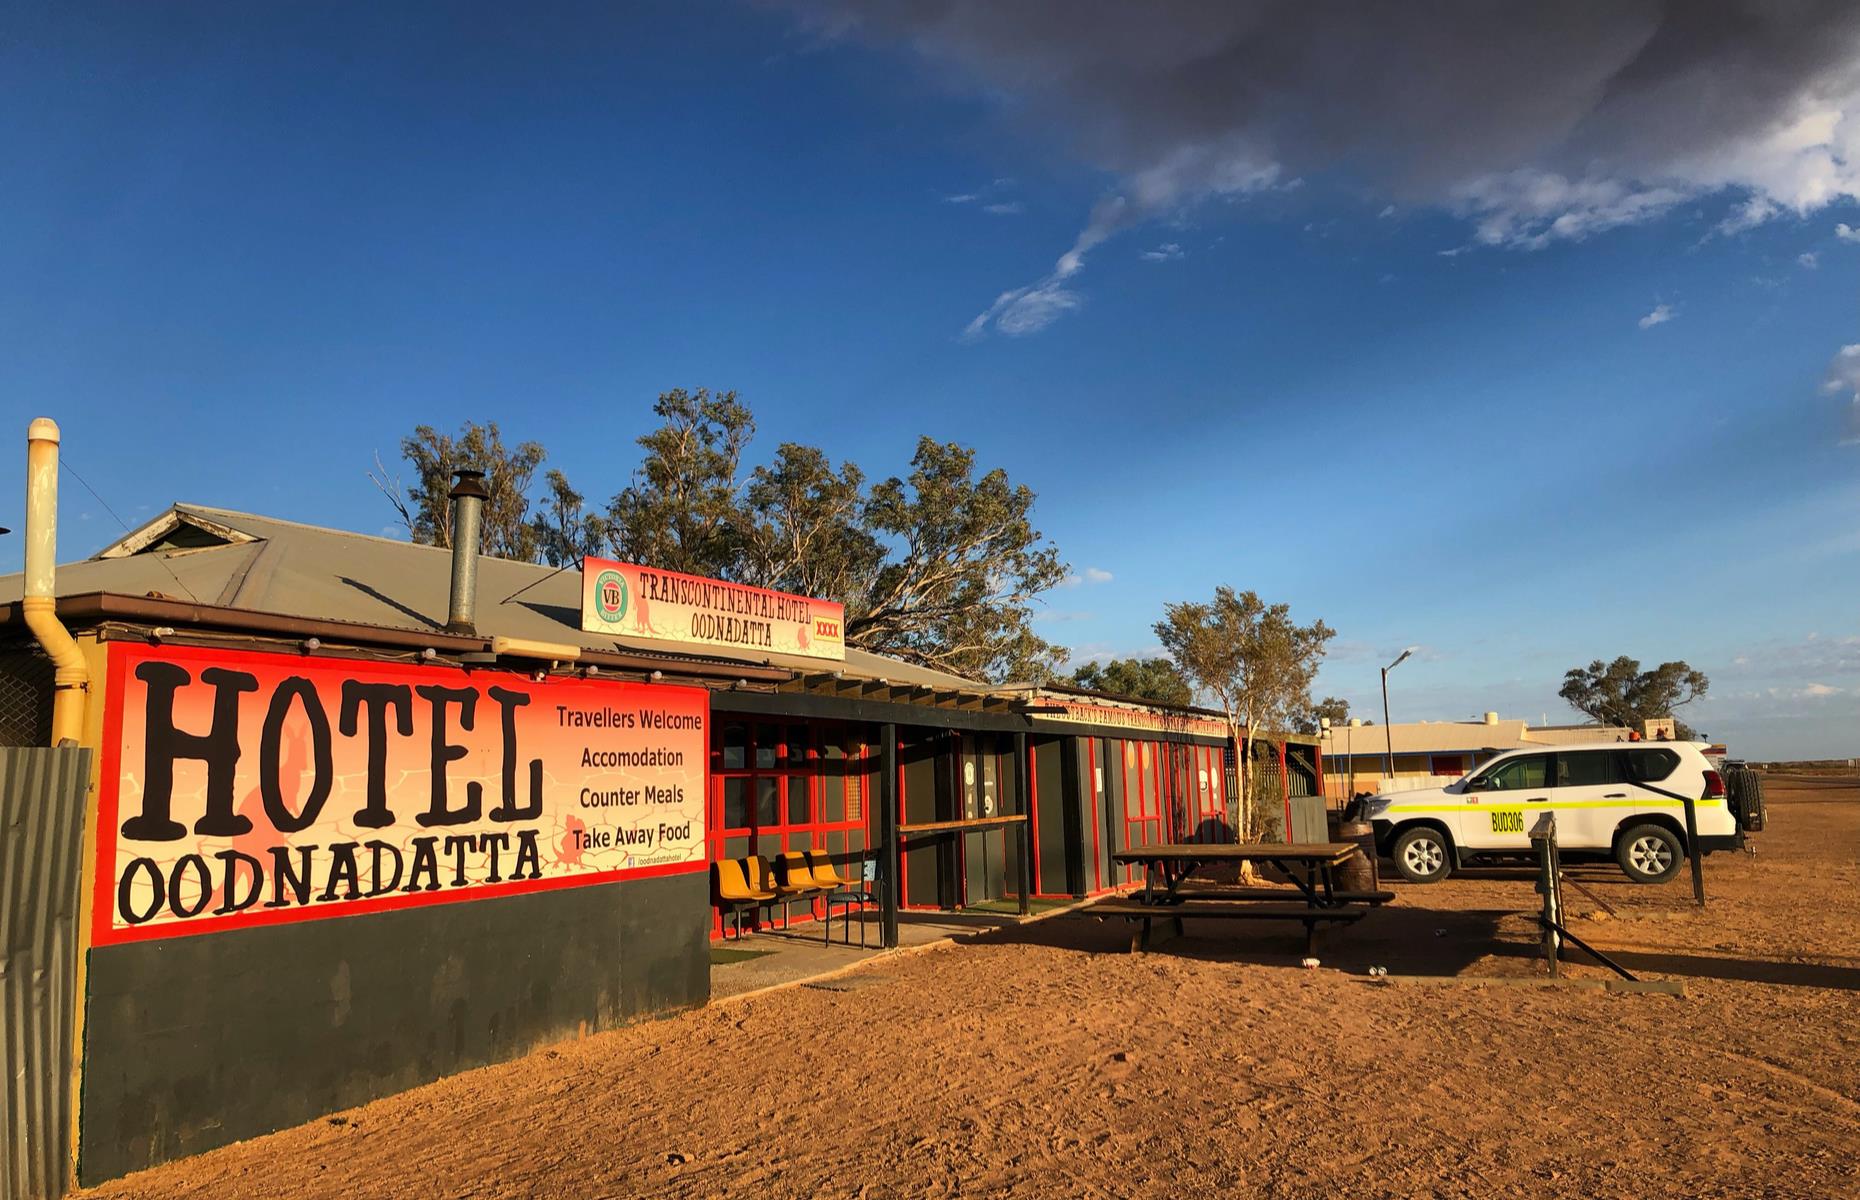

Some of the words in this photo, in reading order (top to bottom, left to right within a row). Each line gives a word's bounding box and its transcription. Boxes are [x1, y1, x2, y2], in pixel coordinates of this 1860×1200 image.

[603, 589, 620, 605] VB
[640, 572, 775, 618] TRANSCONTINENTAL
[776, 596, 811, 625] HOTEL
[691, 613, 773, 647] OODNADATTA
[816, 621, 839, 639] XXXX
[556, 705, 635, 729] Travellers
[640, 708, 702, 730] Welcome
[120, 660, 543, 842] HOTEL
[581, 747, 683, 768] Accomodation
[580, 787, 640, 808] Counter
[645, 784, 684, 804] Meals
[572, 827, 611, 849] Take
[615, 826, 655, 848] Away
[659, 820, 690, 842] Food
[1491, 811, 1524, 833] BUD306
[118, 829, 543, 926] OODNADATTA
